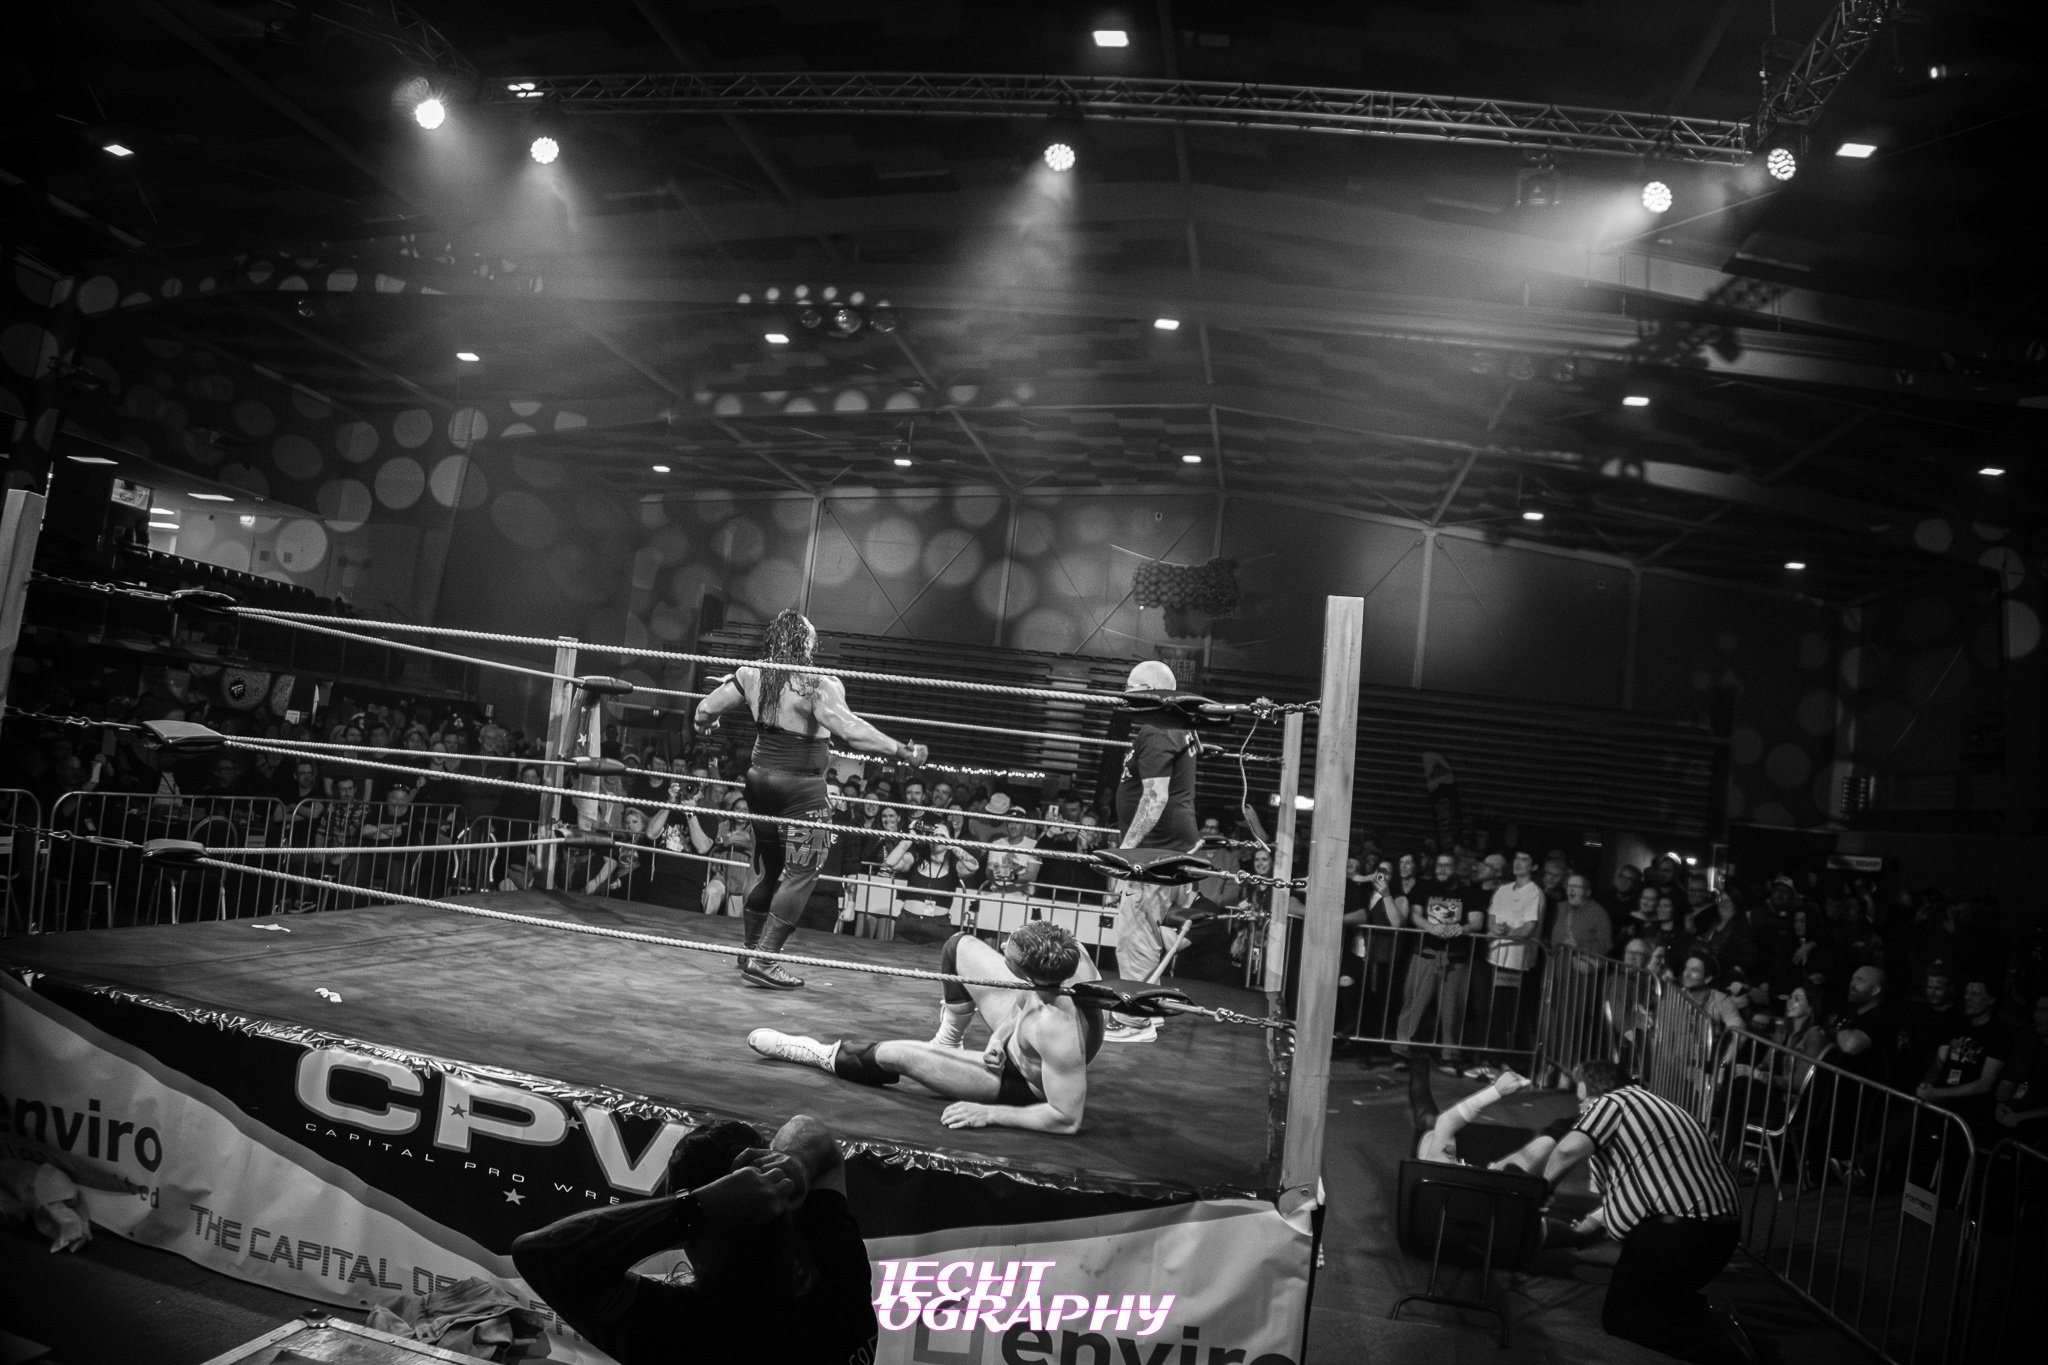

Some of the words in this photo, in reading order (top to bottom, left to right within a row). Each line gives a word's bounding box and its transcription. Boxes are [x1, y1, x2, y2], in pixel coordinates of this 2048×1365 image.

[305, 1123, 435, 1163] CAPITAL
[464, 1161, 525, 1184] PRO
[190, 1204, 242, 1252] THE
[249, 1227, 402, 1290] CAPITAL
[1001, 1322, 1298, 1365] envi
